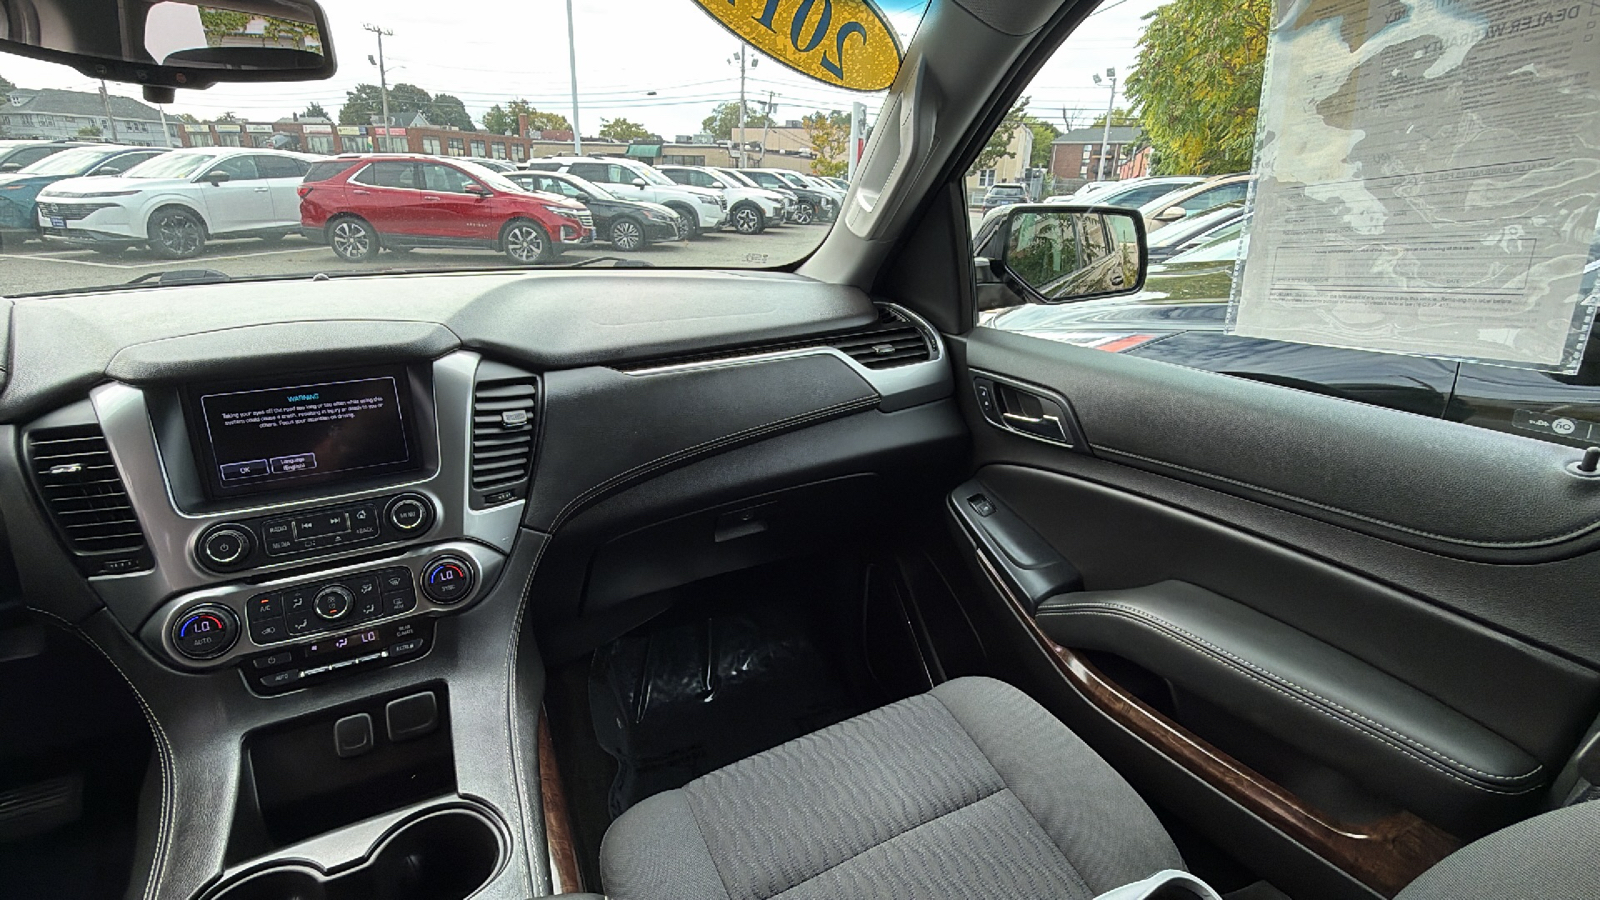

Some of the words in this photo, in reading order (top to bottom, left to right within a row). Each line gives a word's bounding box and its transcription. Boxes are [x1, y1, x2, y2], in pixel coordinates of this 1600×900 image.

[287, 393, 319, 402] WARNING
[400, 511, 416, 519] MENU
[269, 525, 288, 534] RADIO
[272, 541, 291, 550] MEDIA
[194, 637, 212, 646] AUTO
